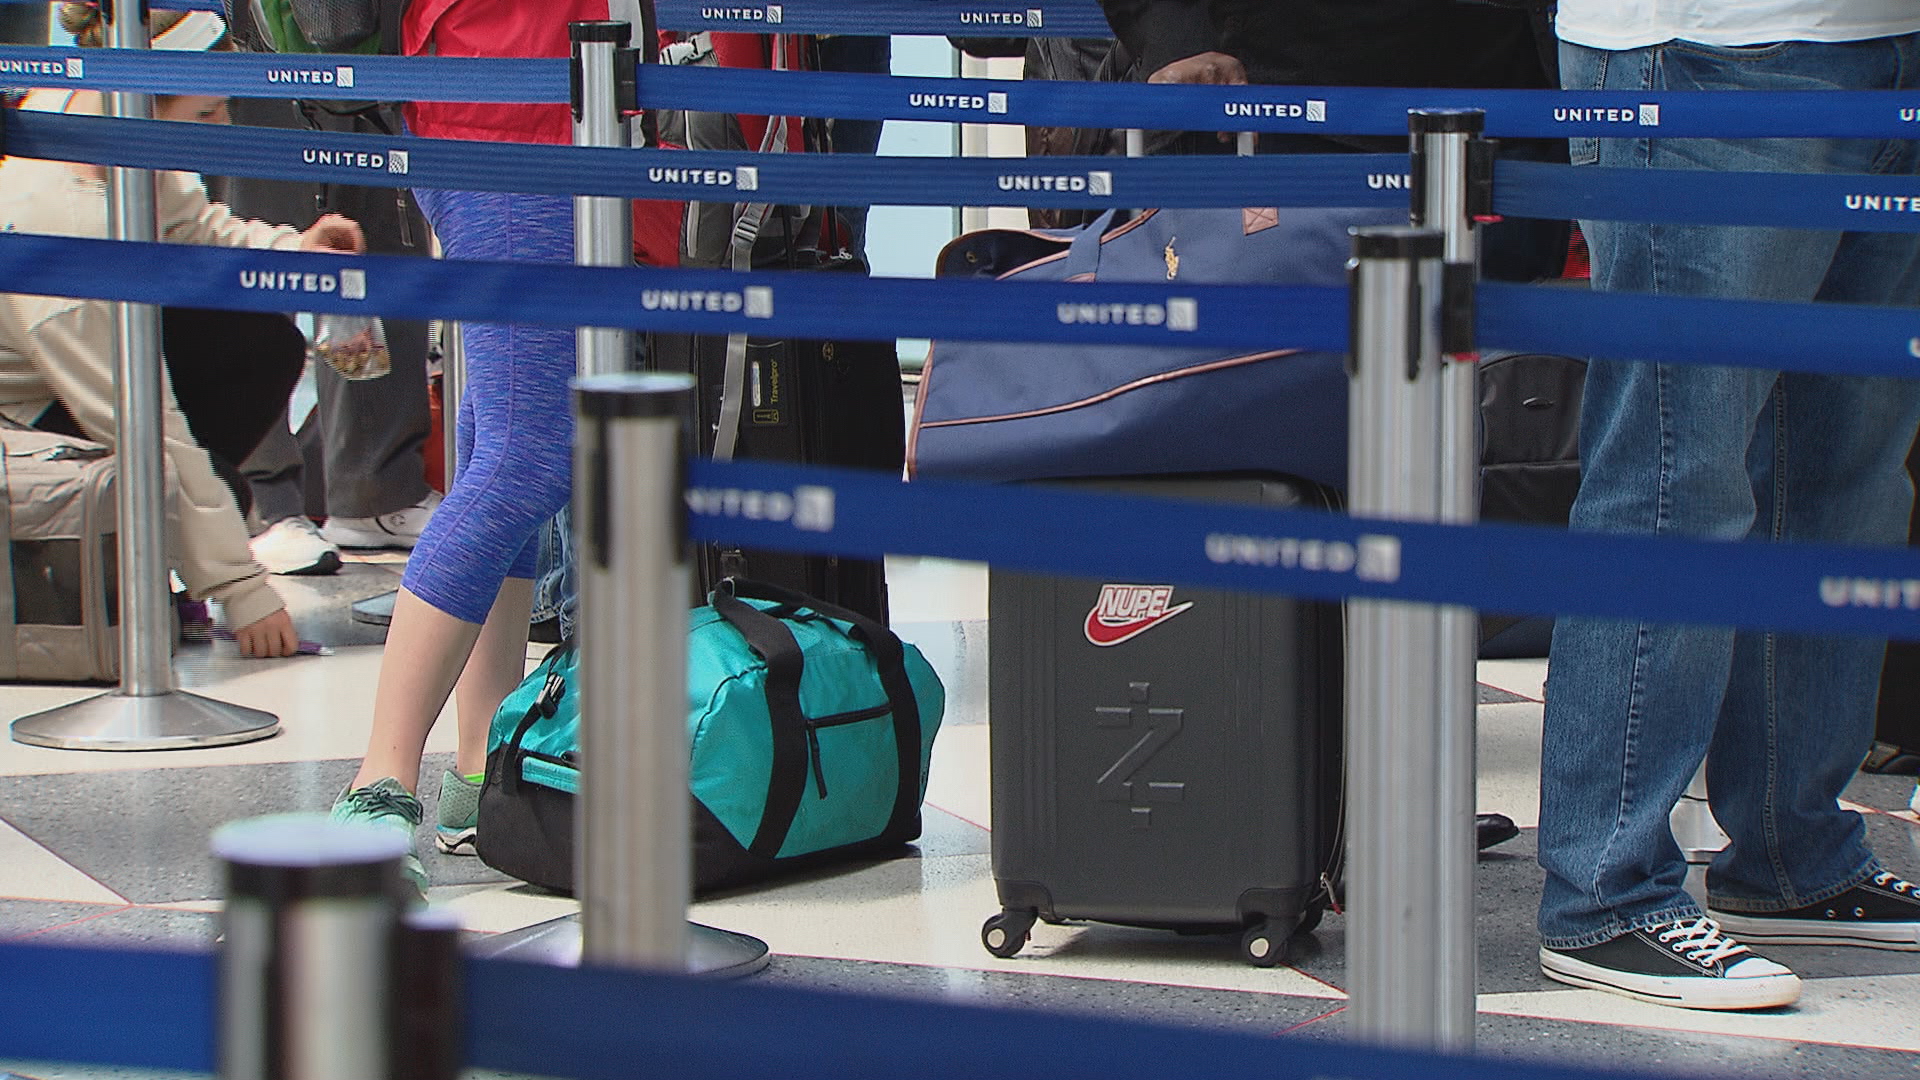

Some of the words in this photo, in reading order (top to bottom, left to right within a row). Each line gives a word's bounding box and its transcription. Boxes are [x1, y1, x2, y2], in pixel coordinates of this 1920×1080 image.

[702, 7, 763, 20] UNITED
[961, 12, 1024, 24] UNITED
[0, 60, 63, 74] UNITED
[267, 70, 334, 83] UNITED
[909, 92, 985, 109] UNITED
[1224, 102, 1303, 117] UNITED
[1554, 108, 1635, 122] UNITED
[303, 149, 384, 168] UNITED
[648, 167, 733, 185] UNITED
[998, 176, 1086, 191] UNITED
[239, 270, 336, 292] UNITED
[642, 289, 742, 312] UNITED
[1058, 302, 1165, 325] UNITED
[1206, 533, 1355, 572] UNITED
[1096, 586, 1170, 617] NUPE
